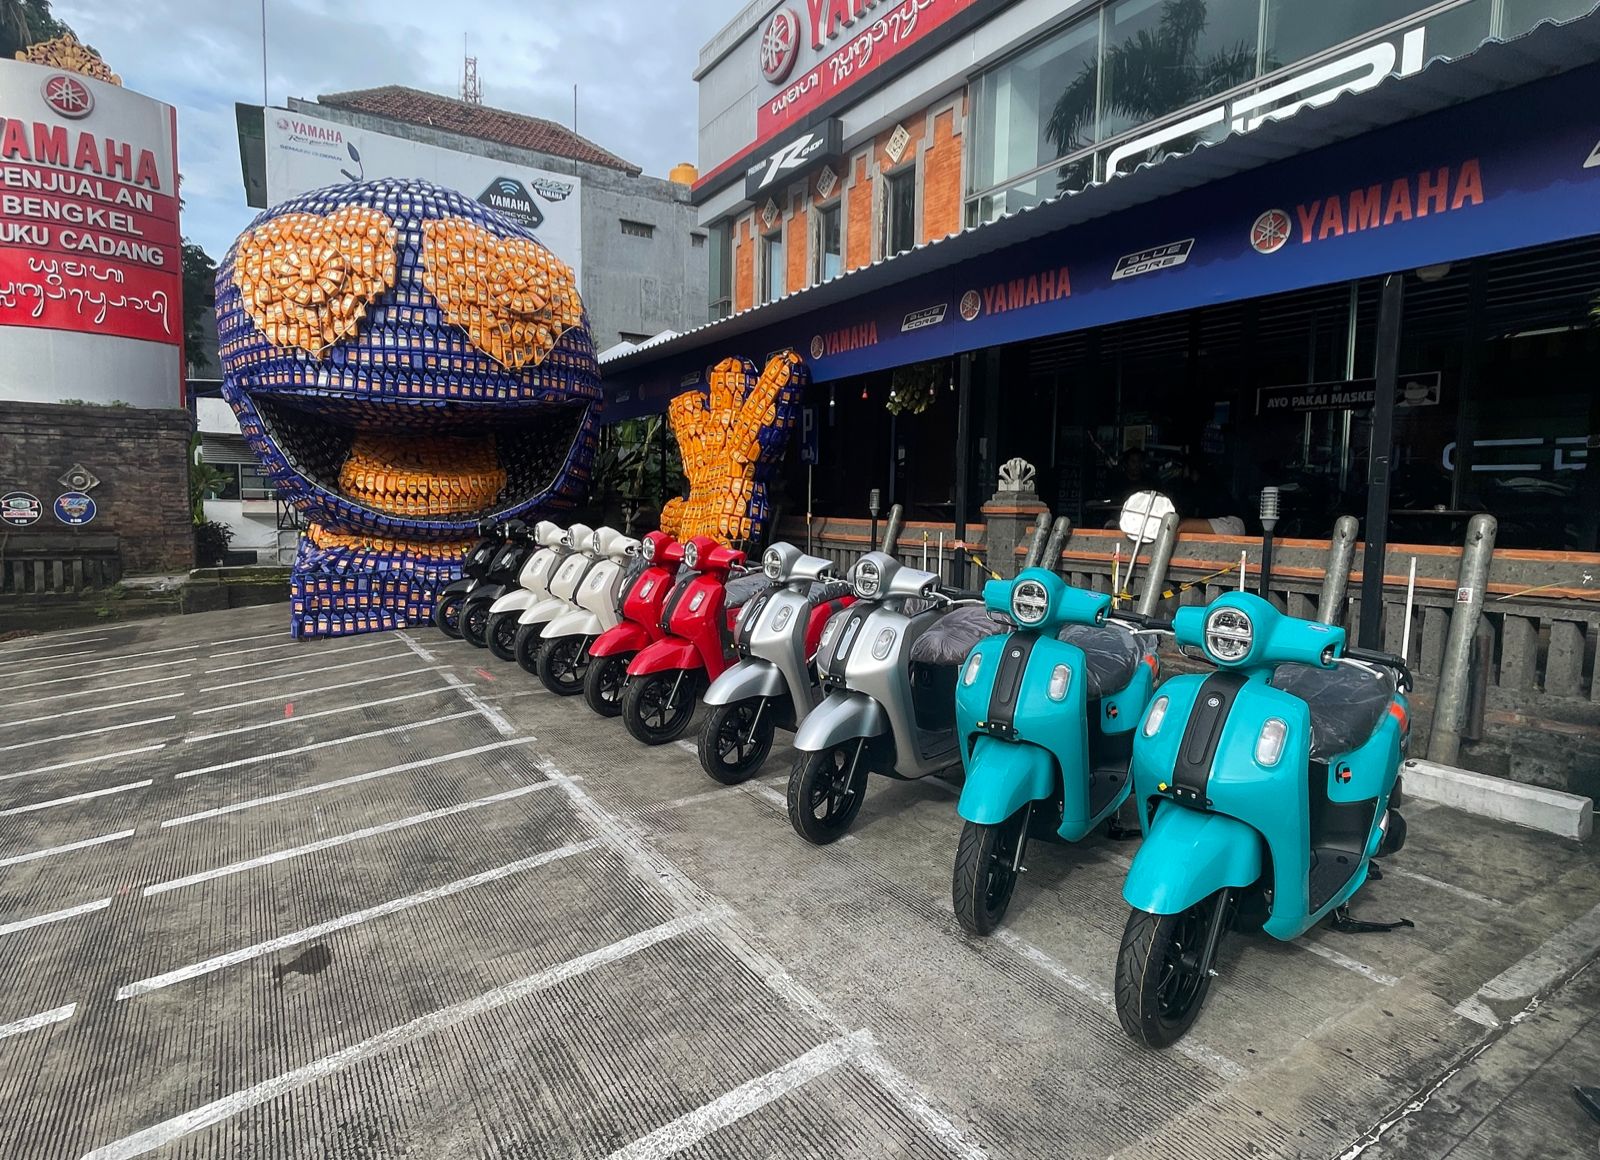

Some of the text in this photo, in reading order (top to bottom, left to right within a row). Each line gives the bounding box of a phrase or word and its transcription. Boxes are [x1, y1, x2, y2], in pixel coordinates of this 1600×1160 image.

[291, 120, 343, 143] YAMAHA
[0, 117, 160, 189] AMAHA
[0, 167, 153, 211] ENJUALAN
[489, 193, 531, 212] YAMAHA
[539, 190, 563, 199] YAMAHA
[1296, 158, 1484, 244] YAMAHA
[2, 195, 143, 235] BENGKEL
[0, 222, 164, 265] UKU CADANG
[1128, 245, 1181, 264] BLUE
[1123, 257, 1176, 275] CORE
[983, 266, 1071, 315] YAMAHA
[825, 320, 878, 355] YAMAHA
[1267, 397, 1289, 408] AYO
[1292, 394, 1328, 407] PAKAI
[1331, 390, 1377, 404] MASKE
